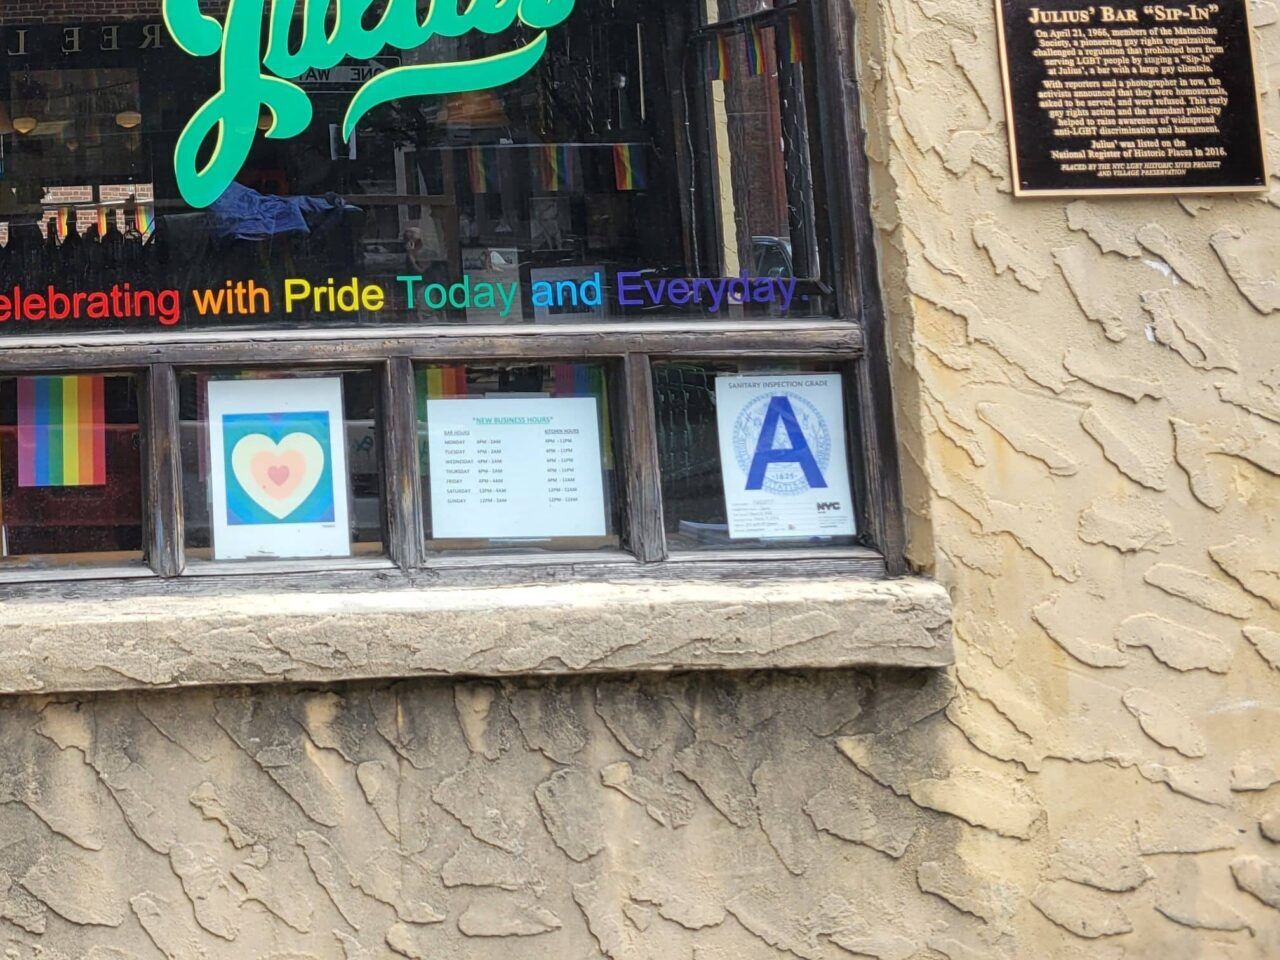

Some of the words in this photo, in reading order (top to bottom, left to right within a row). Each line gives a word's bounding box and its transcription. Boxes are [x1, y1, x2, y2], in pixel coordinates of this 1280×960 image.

[1035, 29, 1047, 38] On
[1050, 29, 1070, 39] April
[1111, 28, 1146, 36] members
[1149, 27, 1157, 36] of
[1160, 27, 1171, 36] the
[1174, 26, 1217, 35] Mattachine
[1080, 38, 1121, 48] pioneering
[1124, 39, 1137, 47] gay
[1140, 37, 1162, 47] rights
[1033, 48, 1075, 58] challenged
[1085, 47, 1124, 57] regulation
[1127, 47, 1141, 55] that
[1144, 46, 1183, 57] prohibited
[1186, 46, 1202, 54] bars
[1205, 45, 1223, 54] from
[1044, 57, 1074, 68] serving
[1076, 57, 1099, 65] LGBT
[1103, 56, 1128, 67] people
[1132, 56, 1141, 66] by
[1144, 56, 1171, 66] staging
[1048, 68, 1056, 76] at
[1097, 66, 1109, 75] bar
[1112, 66, 1129, 74] with
[1139, 65, 1158, 76] large
[1161, 66, 1174, 75] gay
[1042, 80, 1062, 89] With
[1064, 79, 1099, 90] reporters
[1102, 79, 1116, 88] and
[1179, 78, 1187, 86] in
[1208, 77, 1221, 86] the
[1037, 90, 1071, 99] activists
[1073, 89, 1114, 98] announced
[1117, 89, 1132, 97] that
[1135, 88, 1151, 98] they
[1039, 99, 1062, 108] asked
[1065, 99, 1072, 108] to
[1075, 99, 1084, 107] be
[1118, 98, 1131, 107] and
[1188, 97, 1206, 105] This
[1208, 96, 1227, 107] early
[1048, 110, 1063, 119] gay
[1066, 108, 1088, 119] rights
[1091, 108, 1114, 116] action
[1117, 108, 1131, 116] and
[1134, 107, 1146, 116] the
[1149, 107, 1184, 116] attendant
[1186, 106, 1221, 117] publicity
[1057, 118, 1084, 128] helped
[1086, 118, 1094, 126] to
[1097, 117, 1115, 126] raise
[1160, 116, 1168, 125] of
[1171, 115, 1215, 126] widespread
[1053, 127, 1096, 136] anti-LGBT
[1158, 126, 1171, 134] and
[1137, 139, 1158, 148] listed
[1173, 139, 1186, 147] the
[1050, 150, 1085, 159] National
[1088, 150, 1120, 160] Register
[1123, 150, 1131, 158] of
[1134, 149, 1164, 158] Historic
[1168, 149, 1192, 157] Places
[1195, 148, 1202, 157] in
[193, 279, 270, 315] with
[285, 277, 385, 313] Pride
[396, 274, 518, 315] Today
[531, 271, 601, 308] and
[494, 416, 525, 424] BUSINESS
[745, 396, 828, 490] A
[817, 502, 840, 511] NYC
